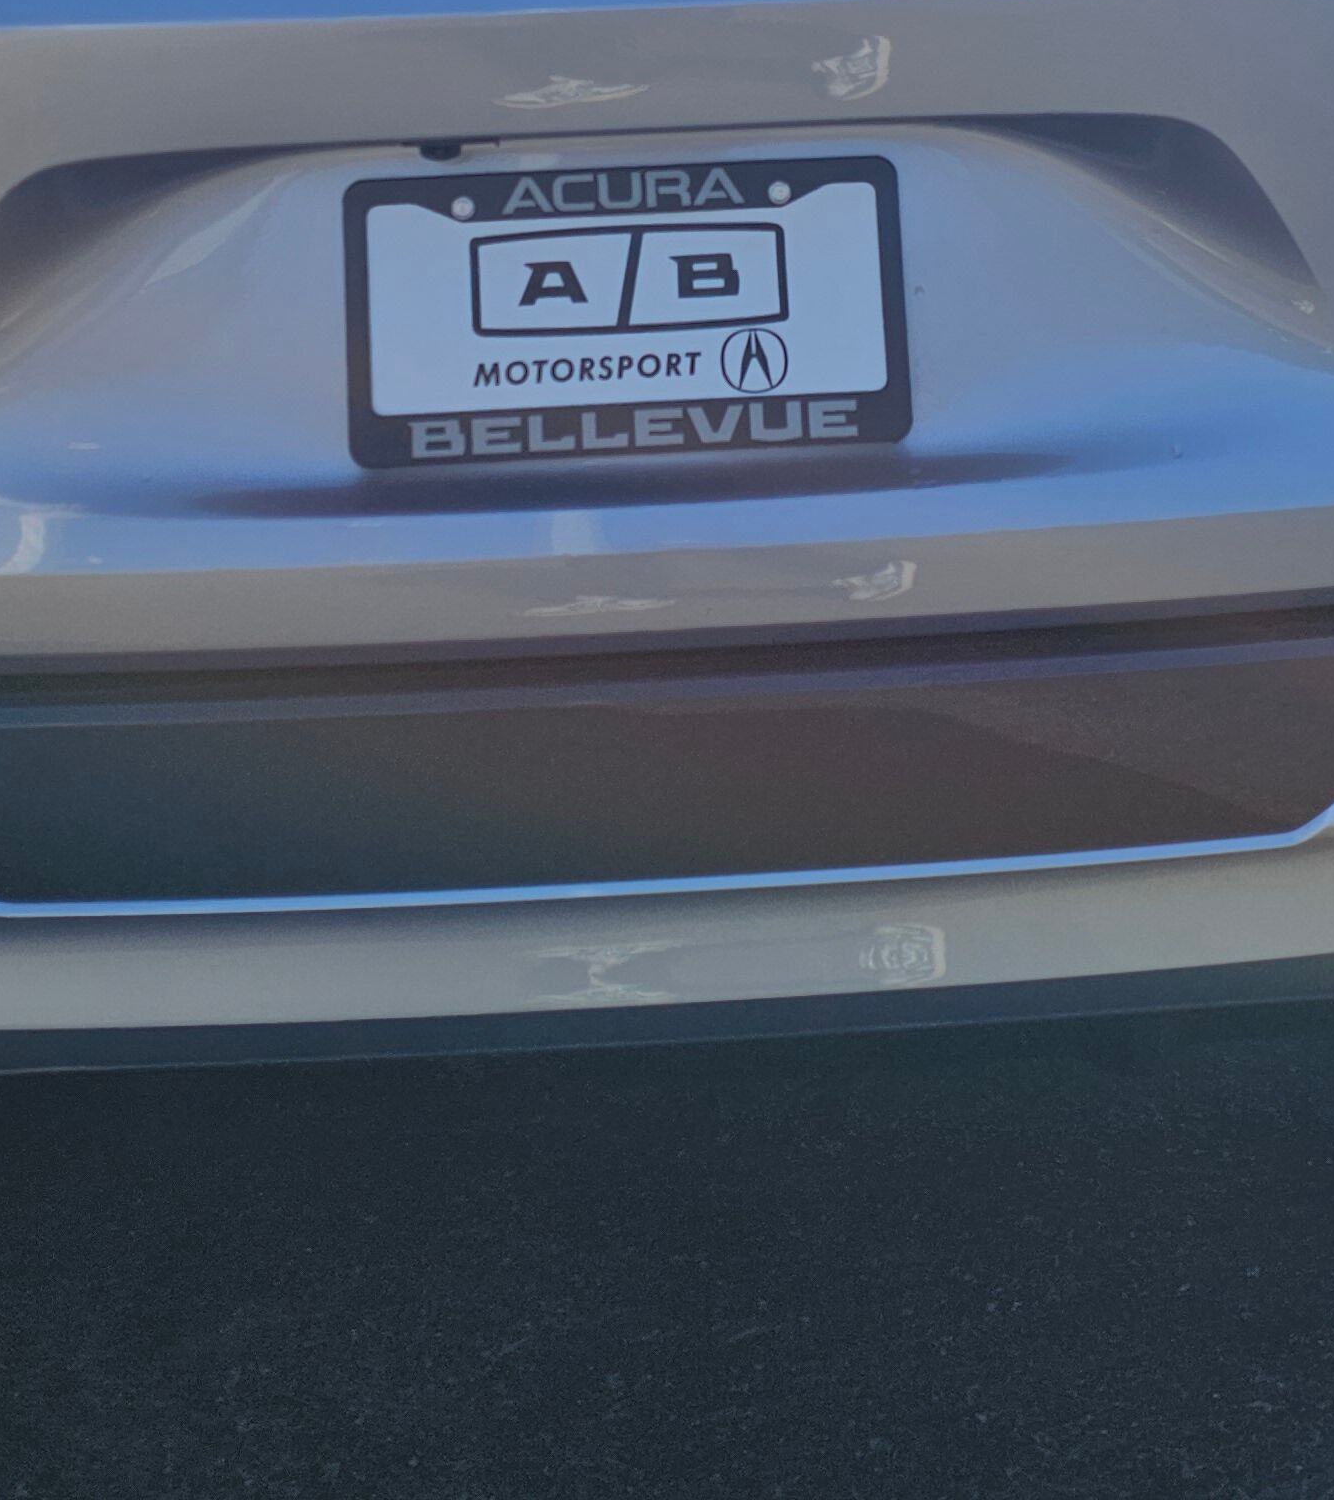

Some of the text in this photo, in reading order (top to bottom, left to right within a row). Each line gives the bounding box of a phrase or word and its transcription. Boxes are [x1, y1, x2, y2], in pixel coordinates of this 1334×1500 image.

[502, 168, 744, 216] ACURA
[473, 351, 701, 388] MOTORSPORT
[407, 399, 859, 460] BELLEVUE
